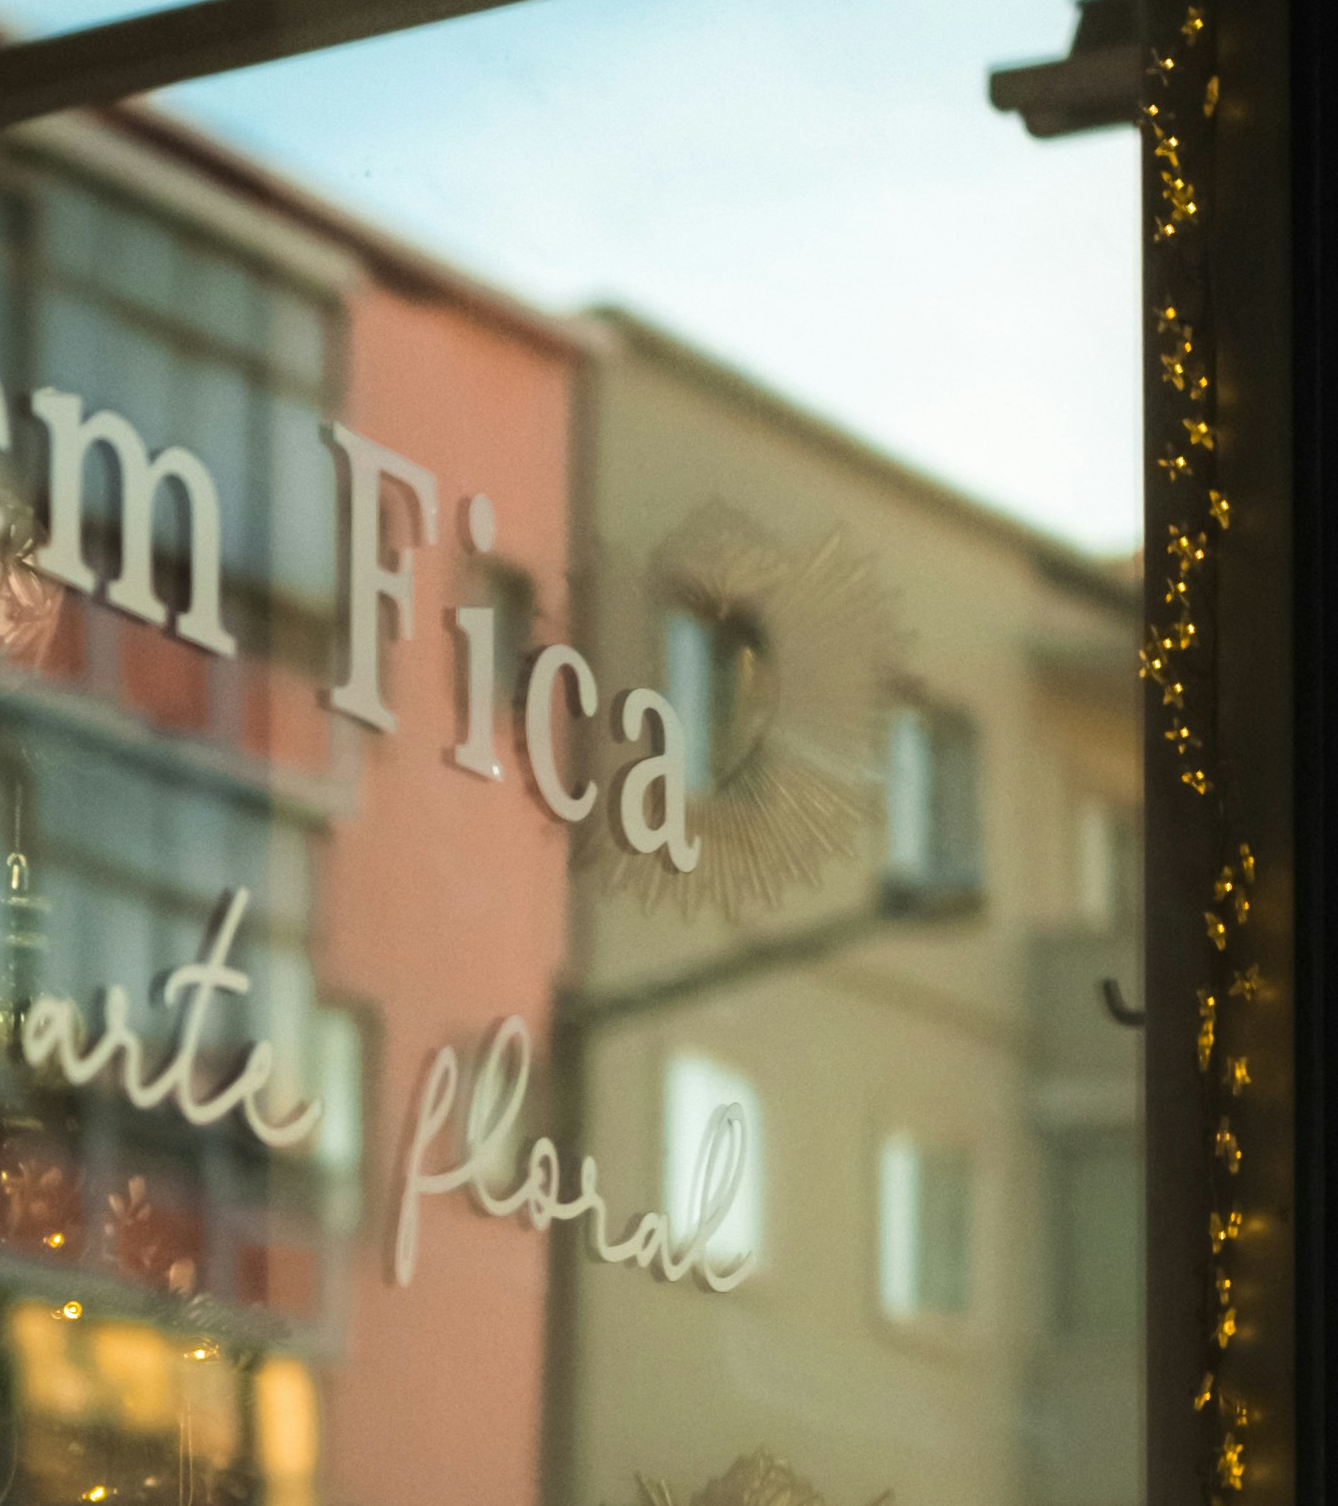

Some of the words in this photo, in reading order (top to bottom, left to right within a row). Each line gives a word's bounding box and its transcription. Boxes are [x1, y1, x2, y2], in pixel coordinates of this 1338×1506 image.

[327, 424, 701, 872] Fica
[23, 890, 317, 1147] arte
[397, 1019, 755, 1290] floral
